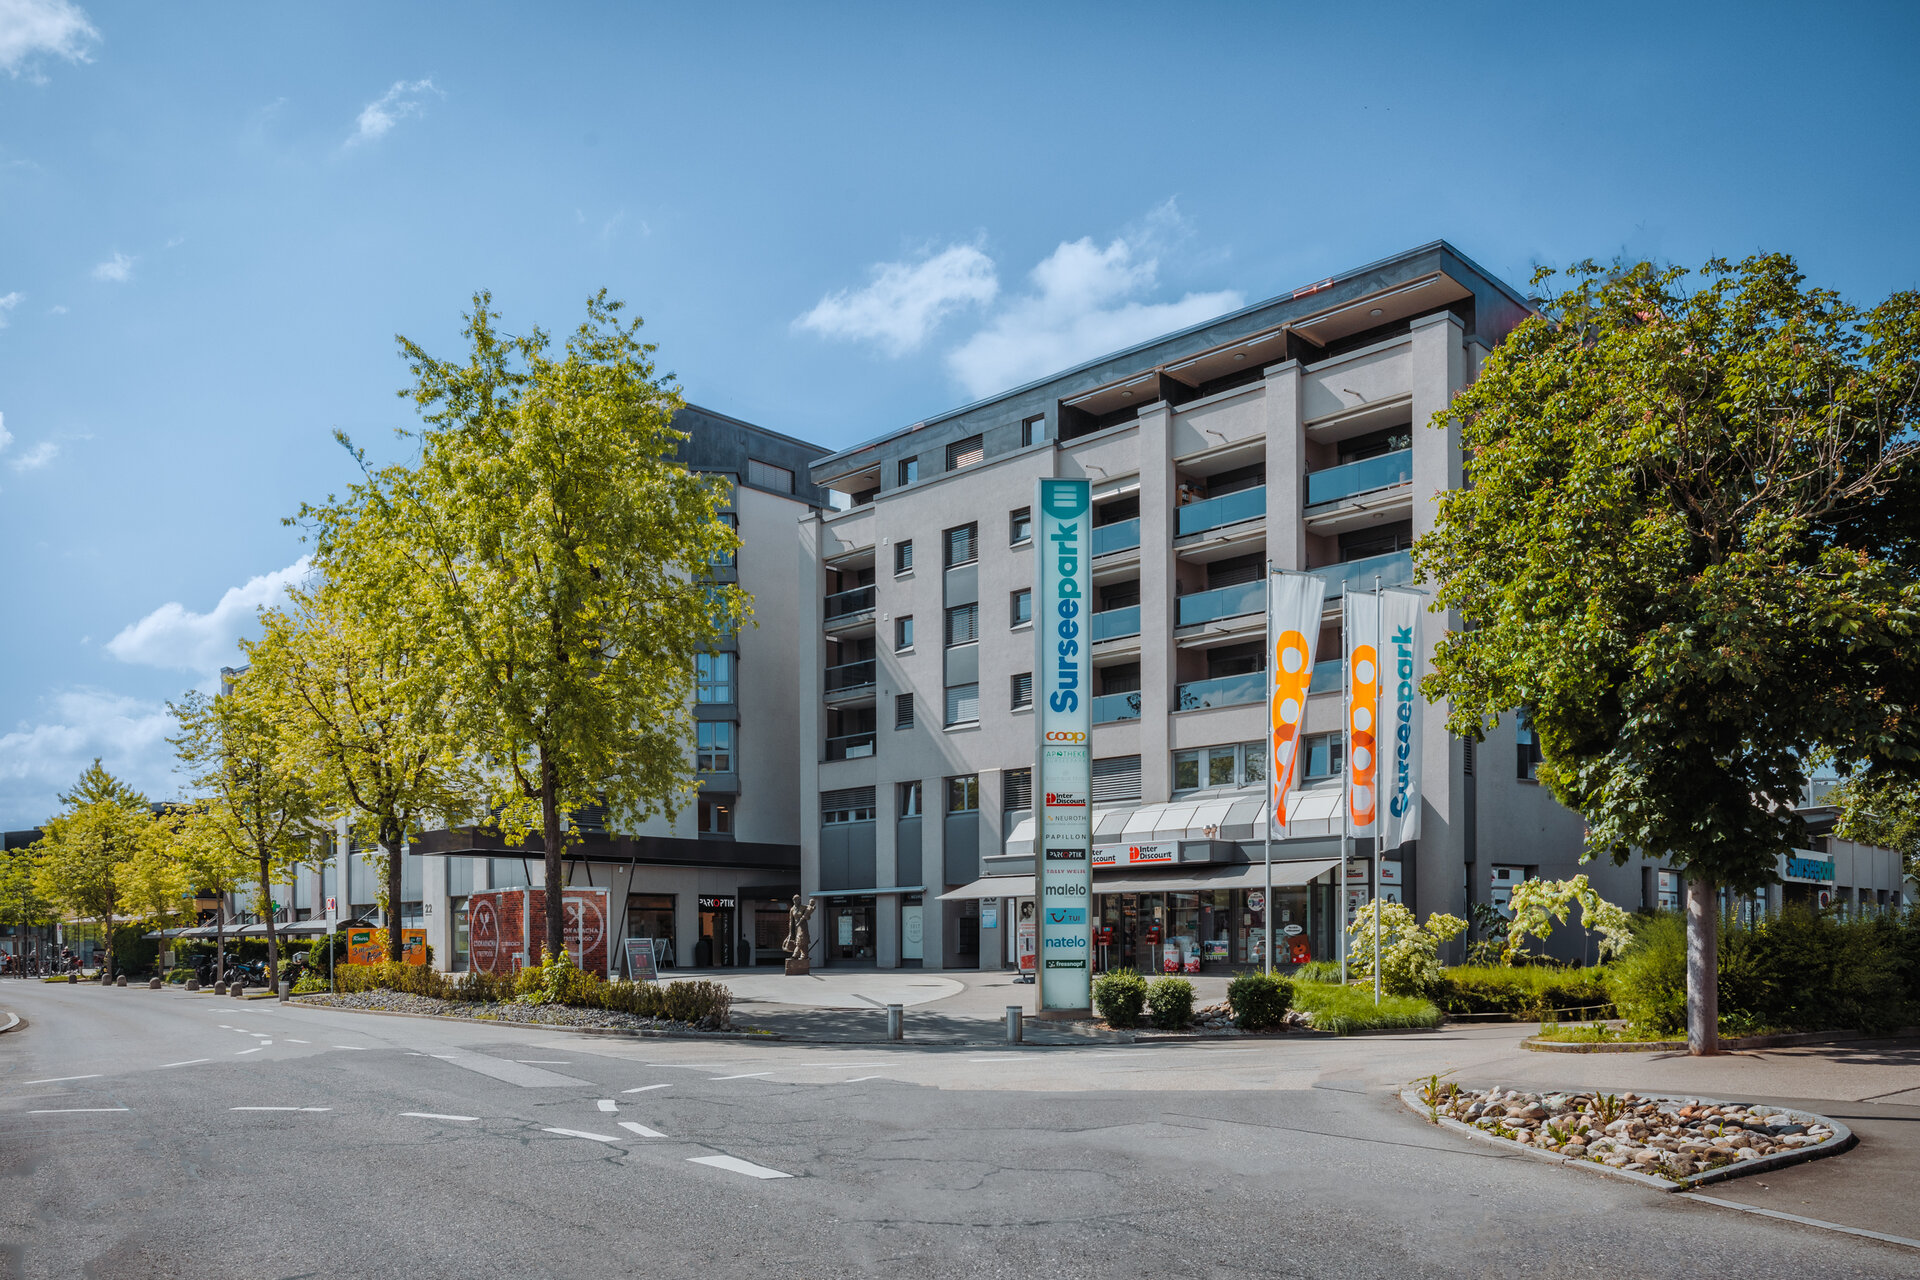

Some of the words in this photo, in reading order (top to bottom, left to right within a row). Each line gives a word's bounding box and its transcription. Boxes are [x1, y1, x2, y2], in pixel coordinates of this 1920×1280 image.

[1050, 522, 1082, 713] Surseepark
[1046, 731, 1086, 744] coop
[1140, 851, 1172, 860] Discount
[1046, 884, 1086, 895] malelo
[425, 904, 433, 913] 22
[1046, 935, 1086, 948] natelo
